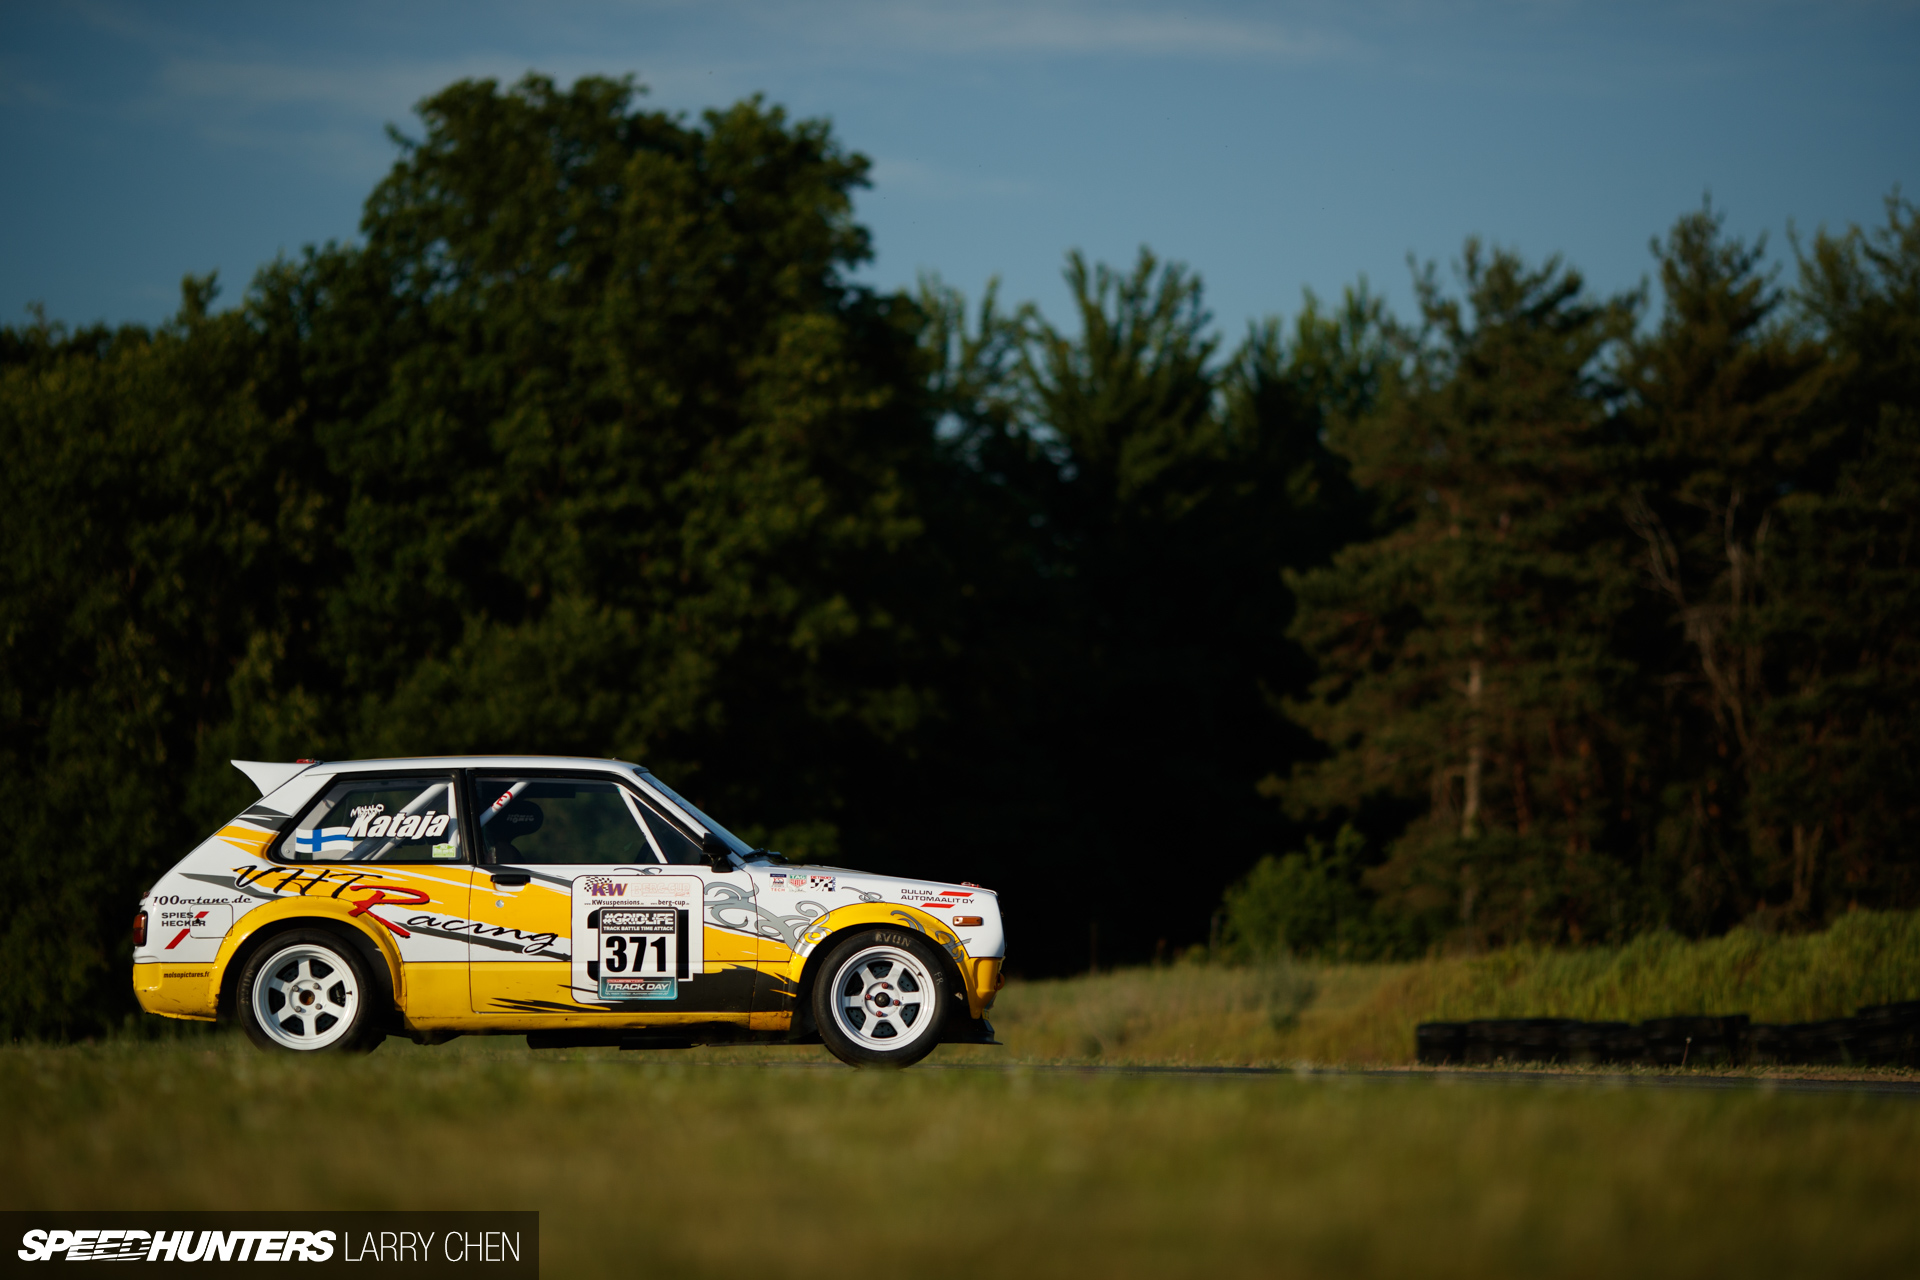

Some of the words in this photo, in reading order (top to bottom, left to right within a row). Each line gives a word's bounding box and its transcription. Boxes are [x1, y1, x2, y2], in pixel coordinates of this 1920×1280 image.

[346, 810, 451, 840] Kataja
[233, 865, 383, 899] VHT
[591, 883, 628, 896] KW
[153, 894, 253, 906] 100octane.de
[900, 894, 960, 904] AUTOMAALIT
[603, 912, 674, 926] #GRIDLIFE
[605, 935, 667, 973] 371
